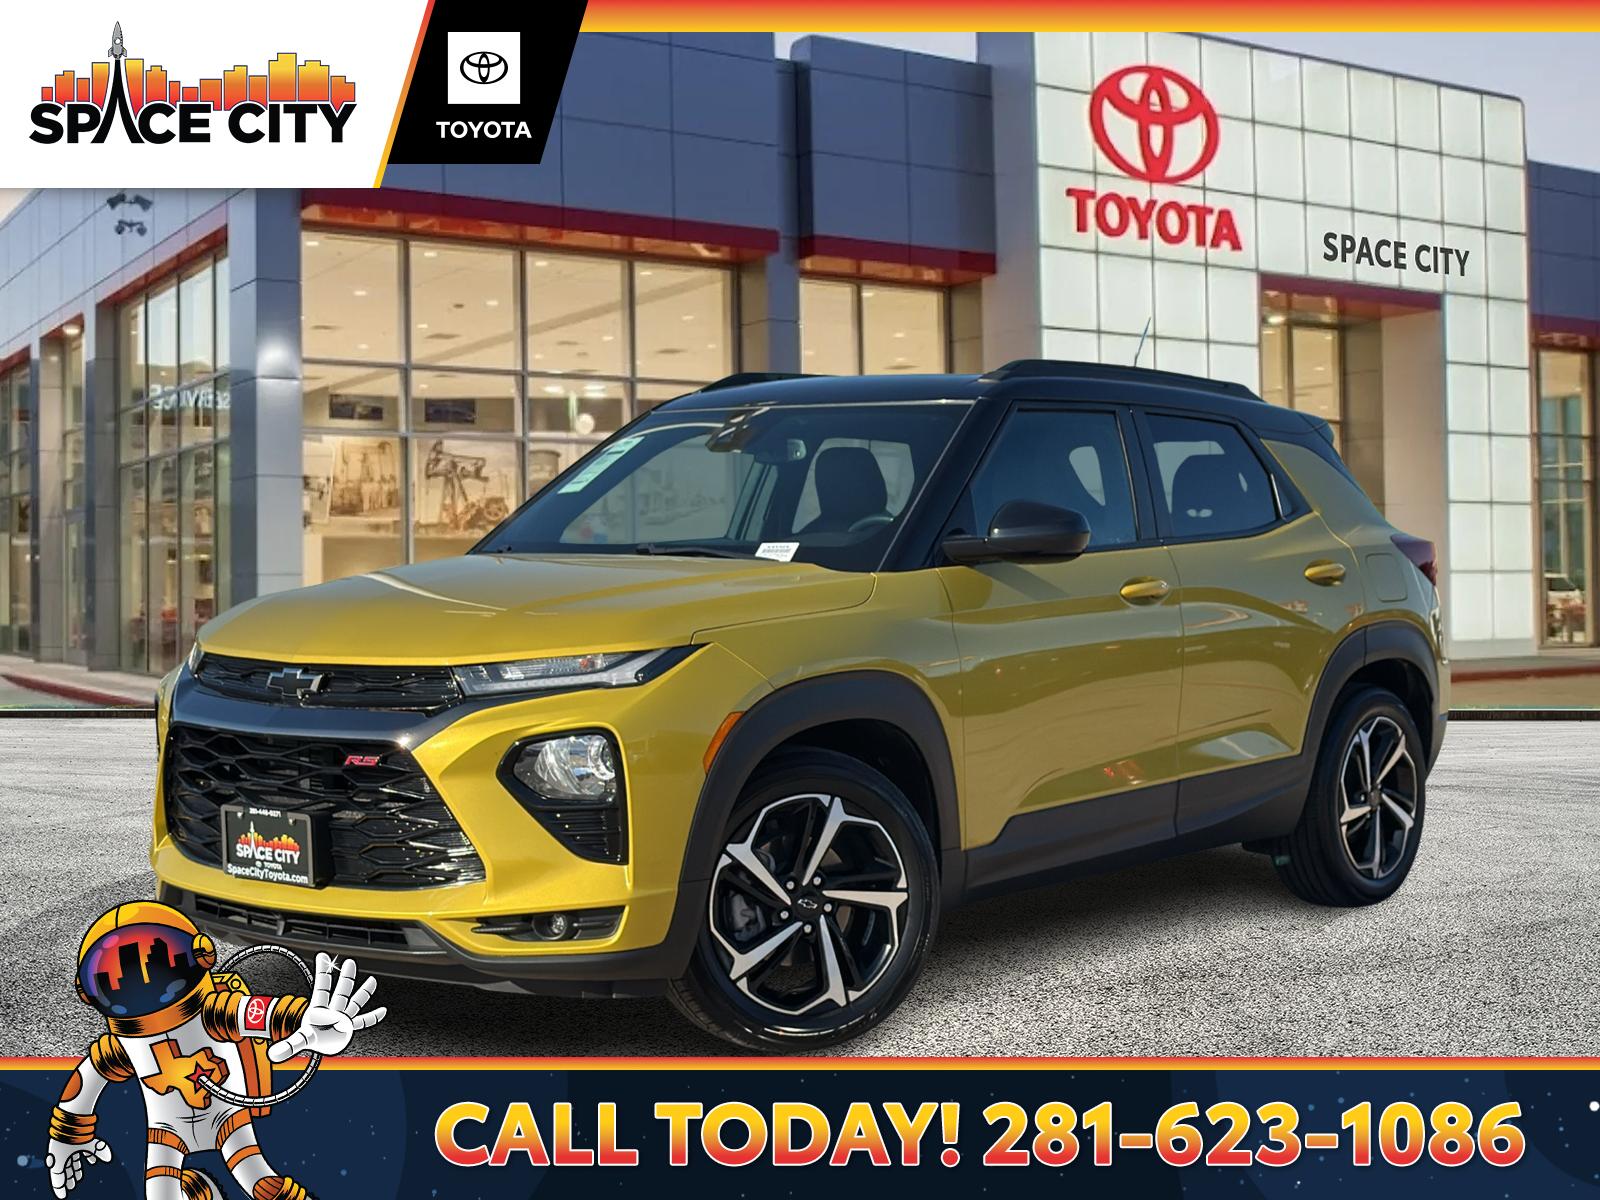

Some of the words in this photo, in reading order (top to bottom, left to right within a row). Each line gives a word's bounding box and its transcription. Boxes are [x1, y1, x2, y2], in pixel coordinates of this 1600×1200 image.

[1066, 187, 1242, 251] TOYOTA
[1323, 232, 1407, 270] SPACE
[1414, 244, 1470, 277] CITY
[345, 755, 380, 766] RS
[274, 849, 300, 865] CITY
[227, 863, 309, 884] SpaceCityToyota.com
